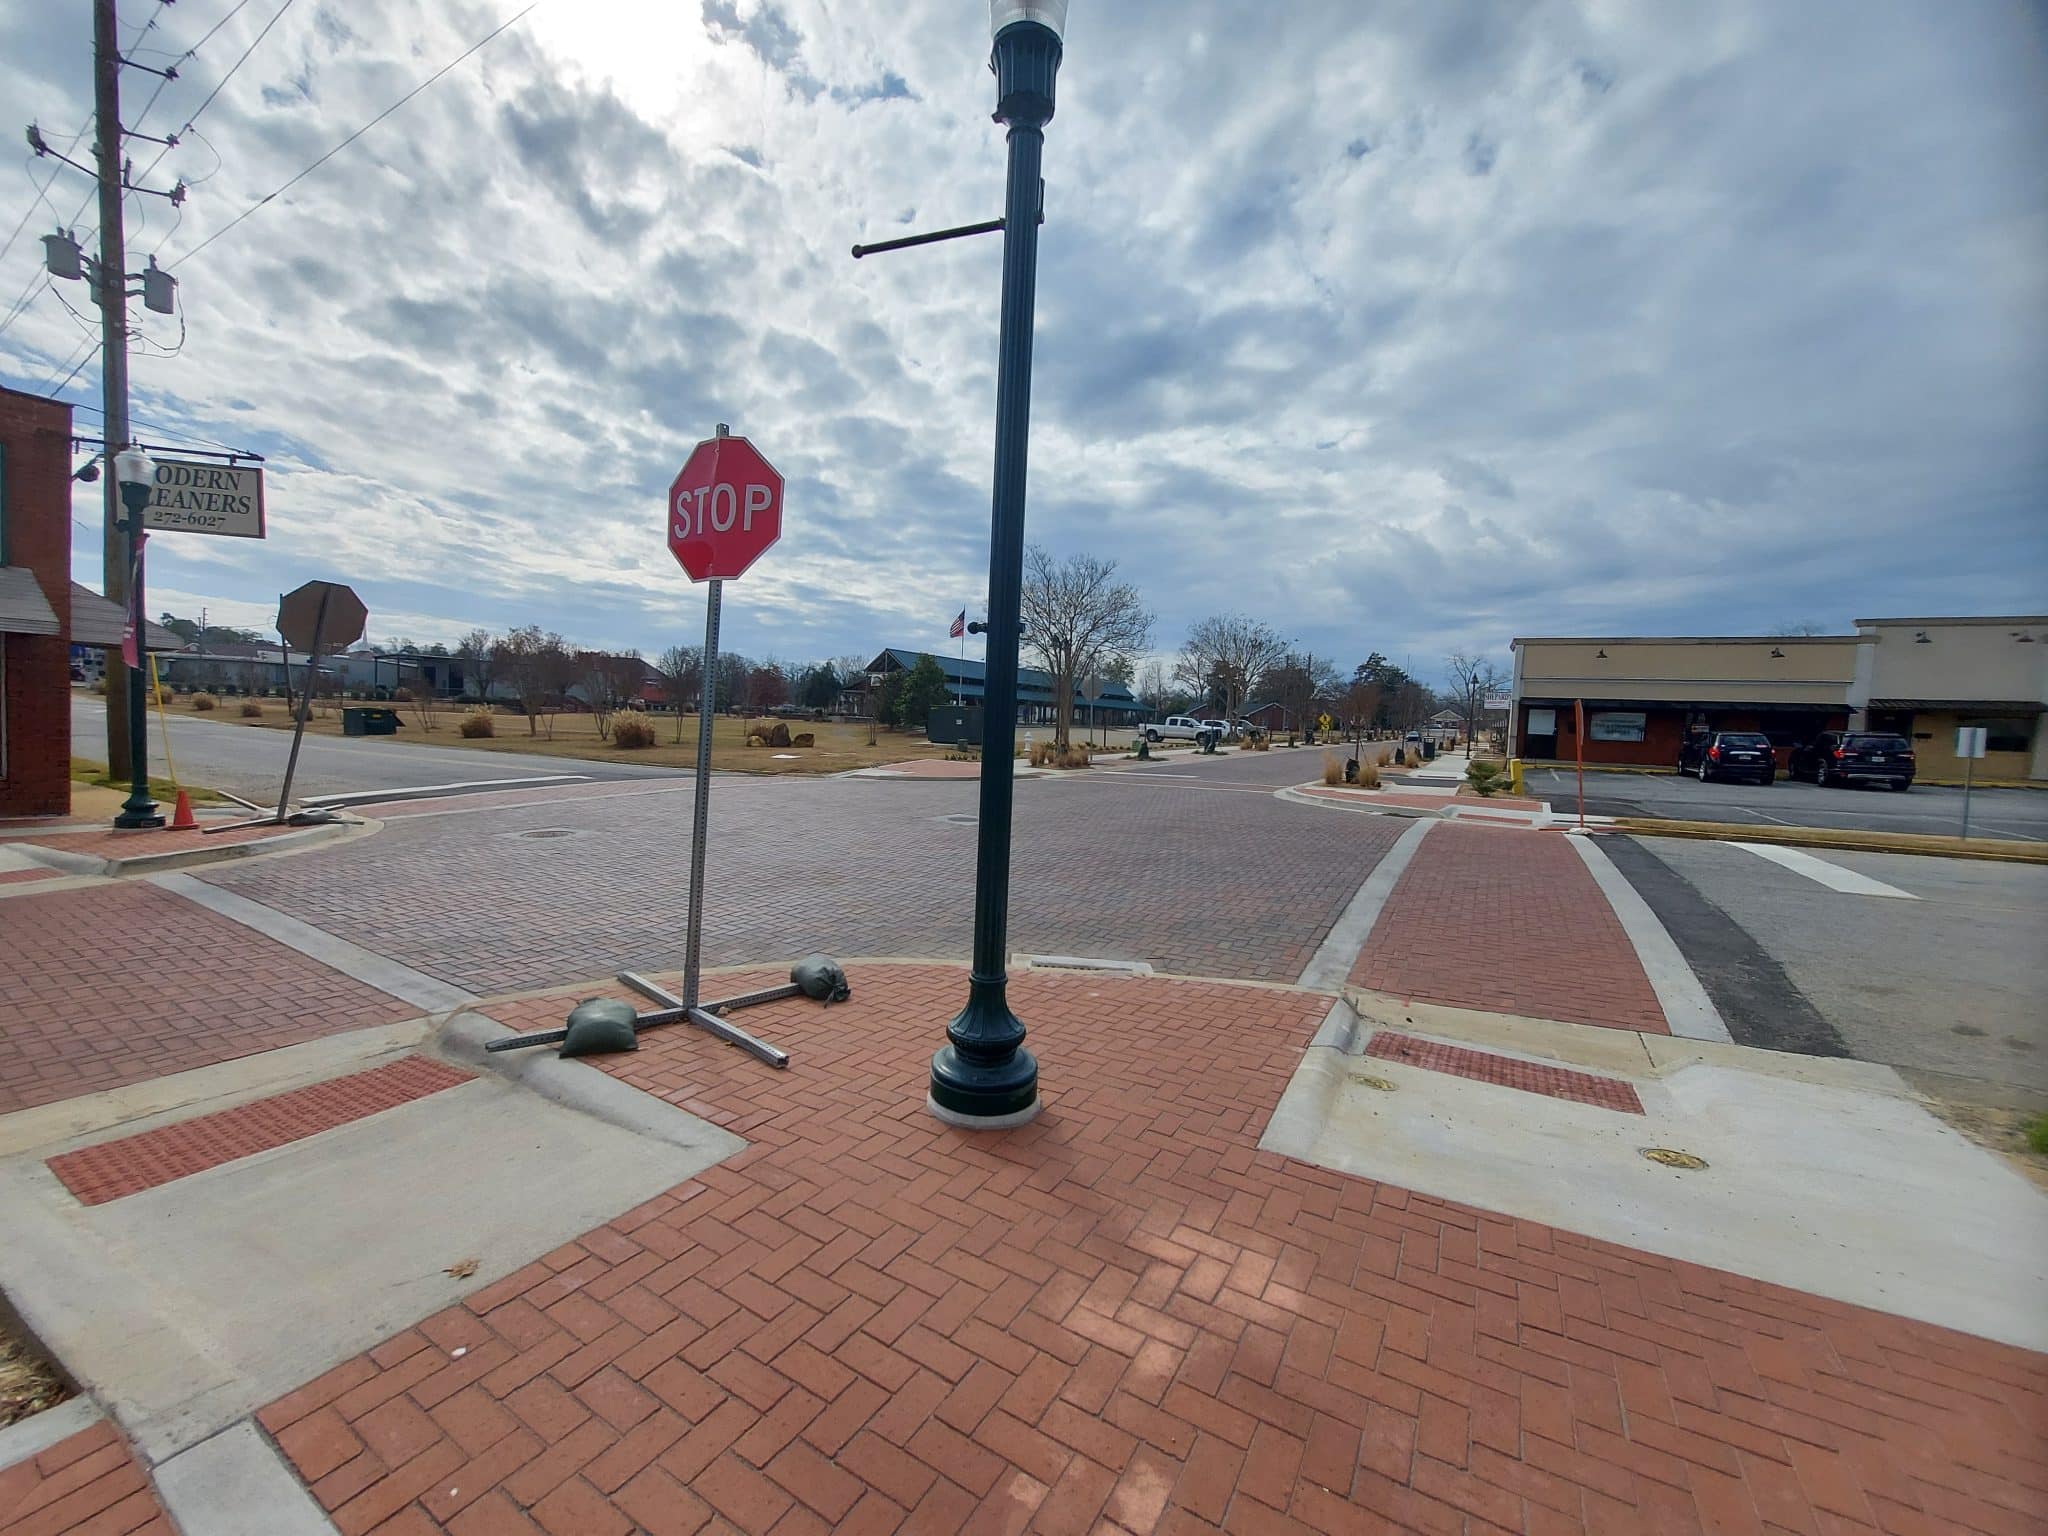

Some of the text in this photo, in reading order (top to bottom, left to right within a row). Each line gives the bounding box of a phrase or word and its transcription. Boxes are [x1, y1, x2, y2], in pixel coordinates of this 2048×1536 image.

[155, 465, 242, 491] ODERN
[150, 487, 252, 515] EANERS
[674, 482, 773, 539] STOP
[153, 511, 227, 529] 272-6027
